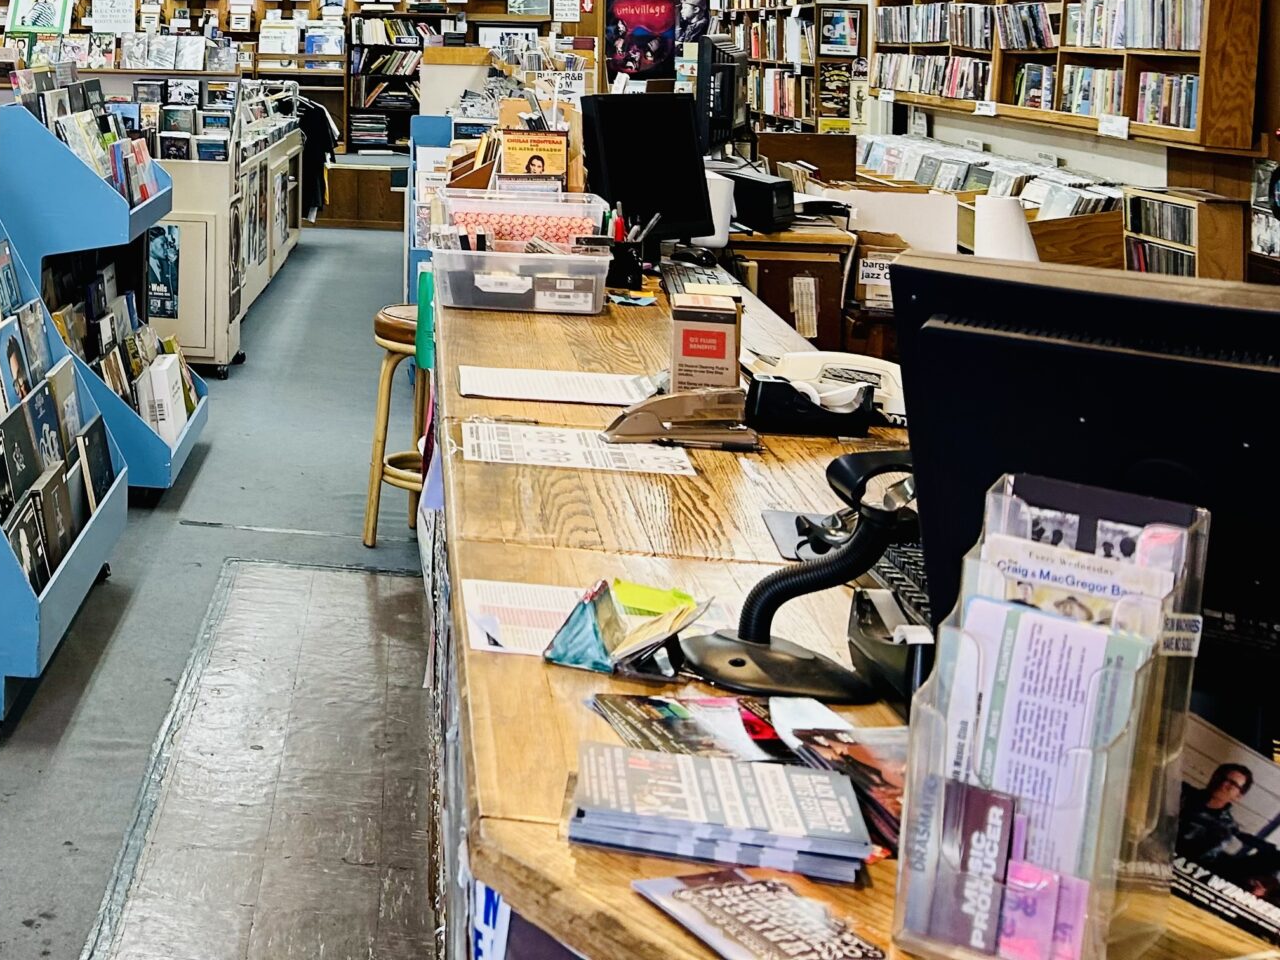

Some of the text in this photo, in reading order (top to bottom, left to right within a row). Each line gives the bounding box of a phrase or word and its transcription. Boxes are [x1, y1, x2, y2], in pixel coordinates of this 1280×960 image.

[861, 271, 881, 281] jazz
[862, 259, 890, 271] barga
[151, 283, 167, 293] Wells
[997, 559, 1028, 579] Craig
[1038, 568, 1108, 594] MacGregor
[960, 830, 987, 916] MUSIC
[970, 804, 1005, 948] PRODUCER
